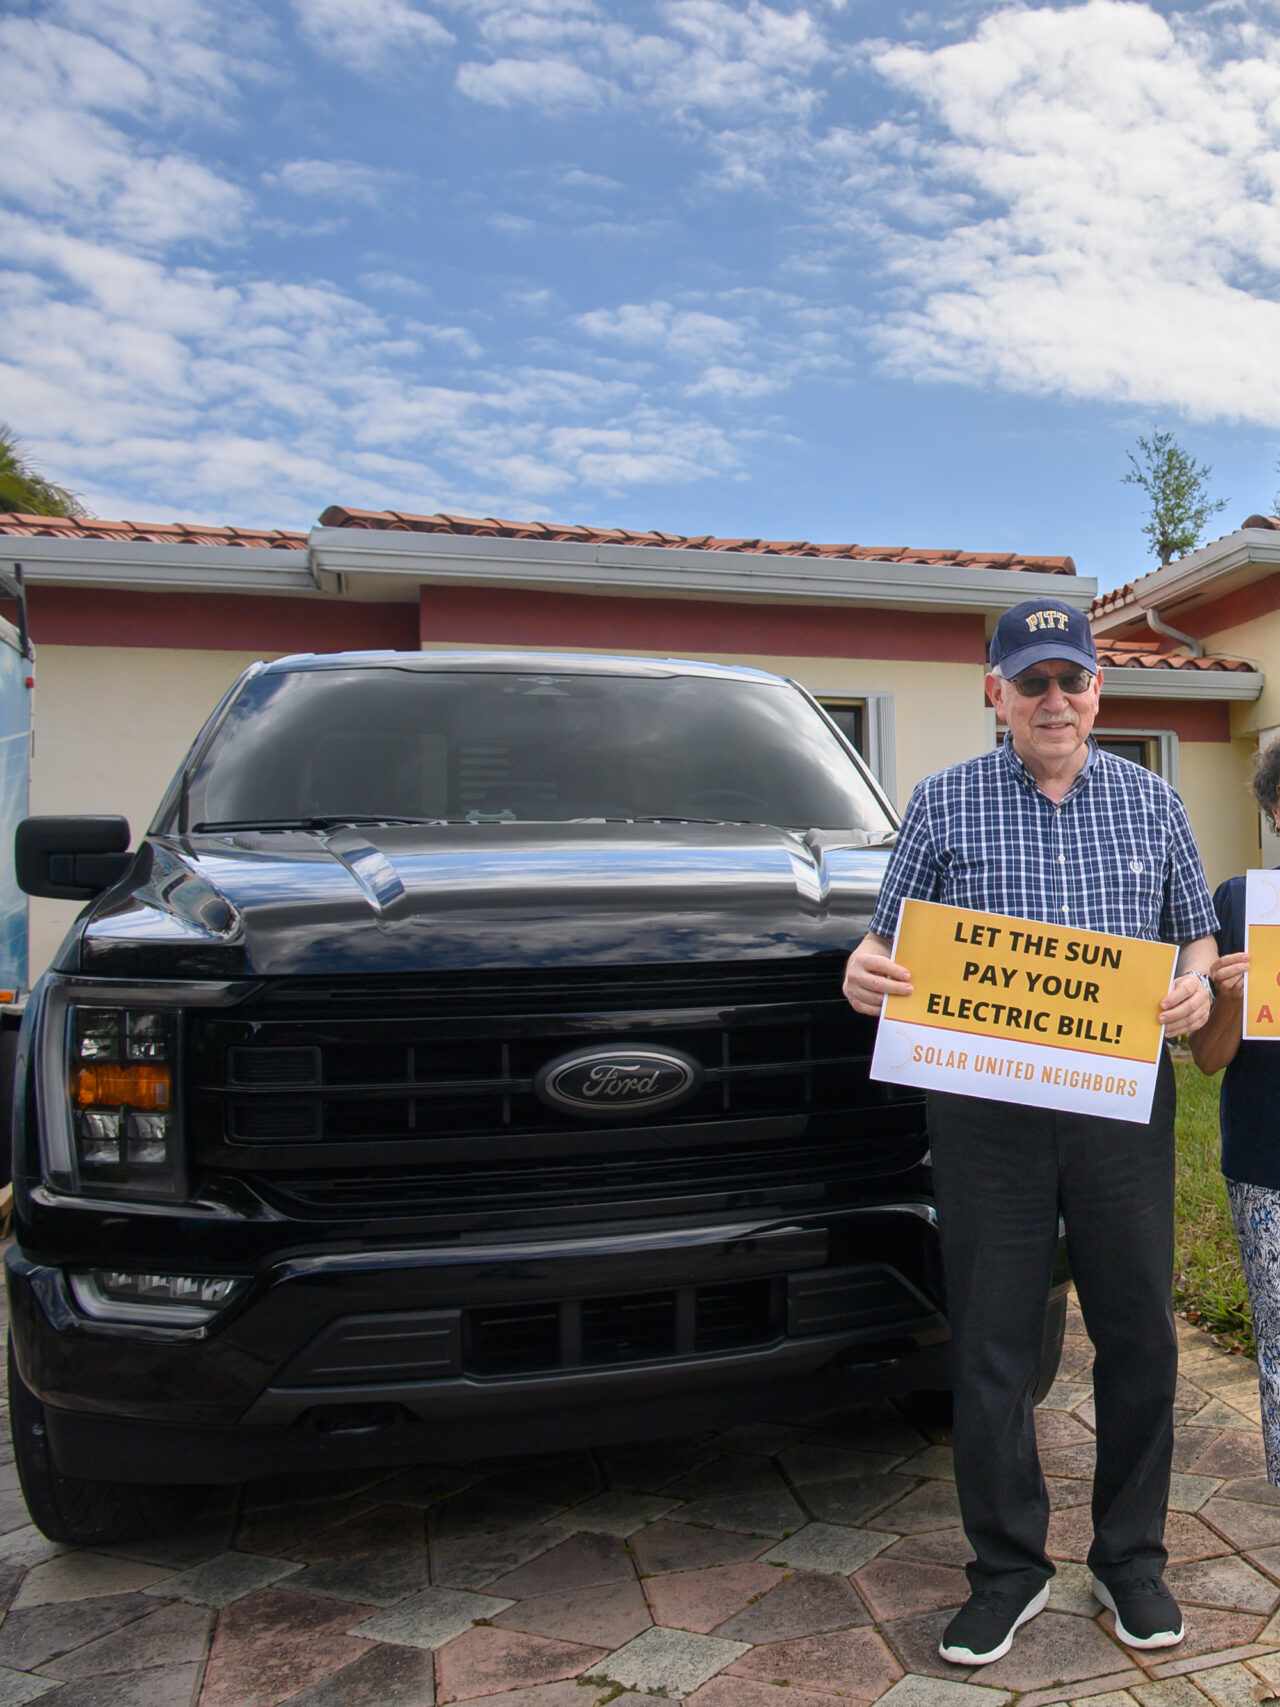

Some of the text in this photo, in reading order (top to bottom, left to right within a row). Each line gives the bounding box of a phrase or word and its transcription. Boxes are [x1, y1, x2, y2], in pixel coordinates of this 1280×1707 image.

[1026, 610, 1069, 632] PITT
[954, 922, 1123, 969] LET THE SUN
[962, 961, 1100, 1003] PAY YOUR
[927, 993, 1123, 1045] ELECTRIC BILL!
[1256, 1005, 1274, 1024] A
[582, 1064, 660, 1096] Ford
[912, 1044, 1138, 1097] SOLAR UNITED NEIGHBORS
